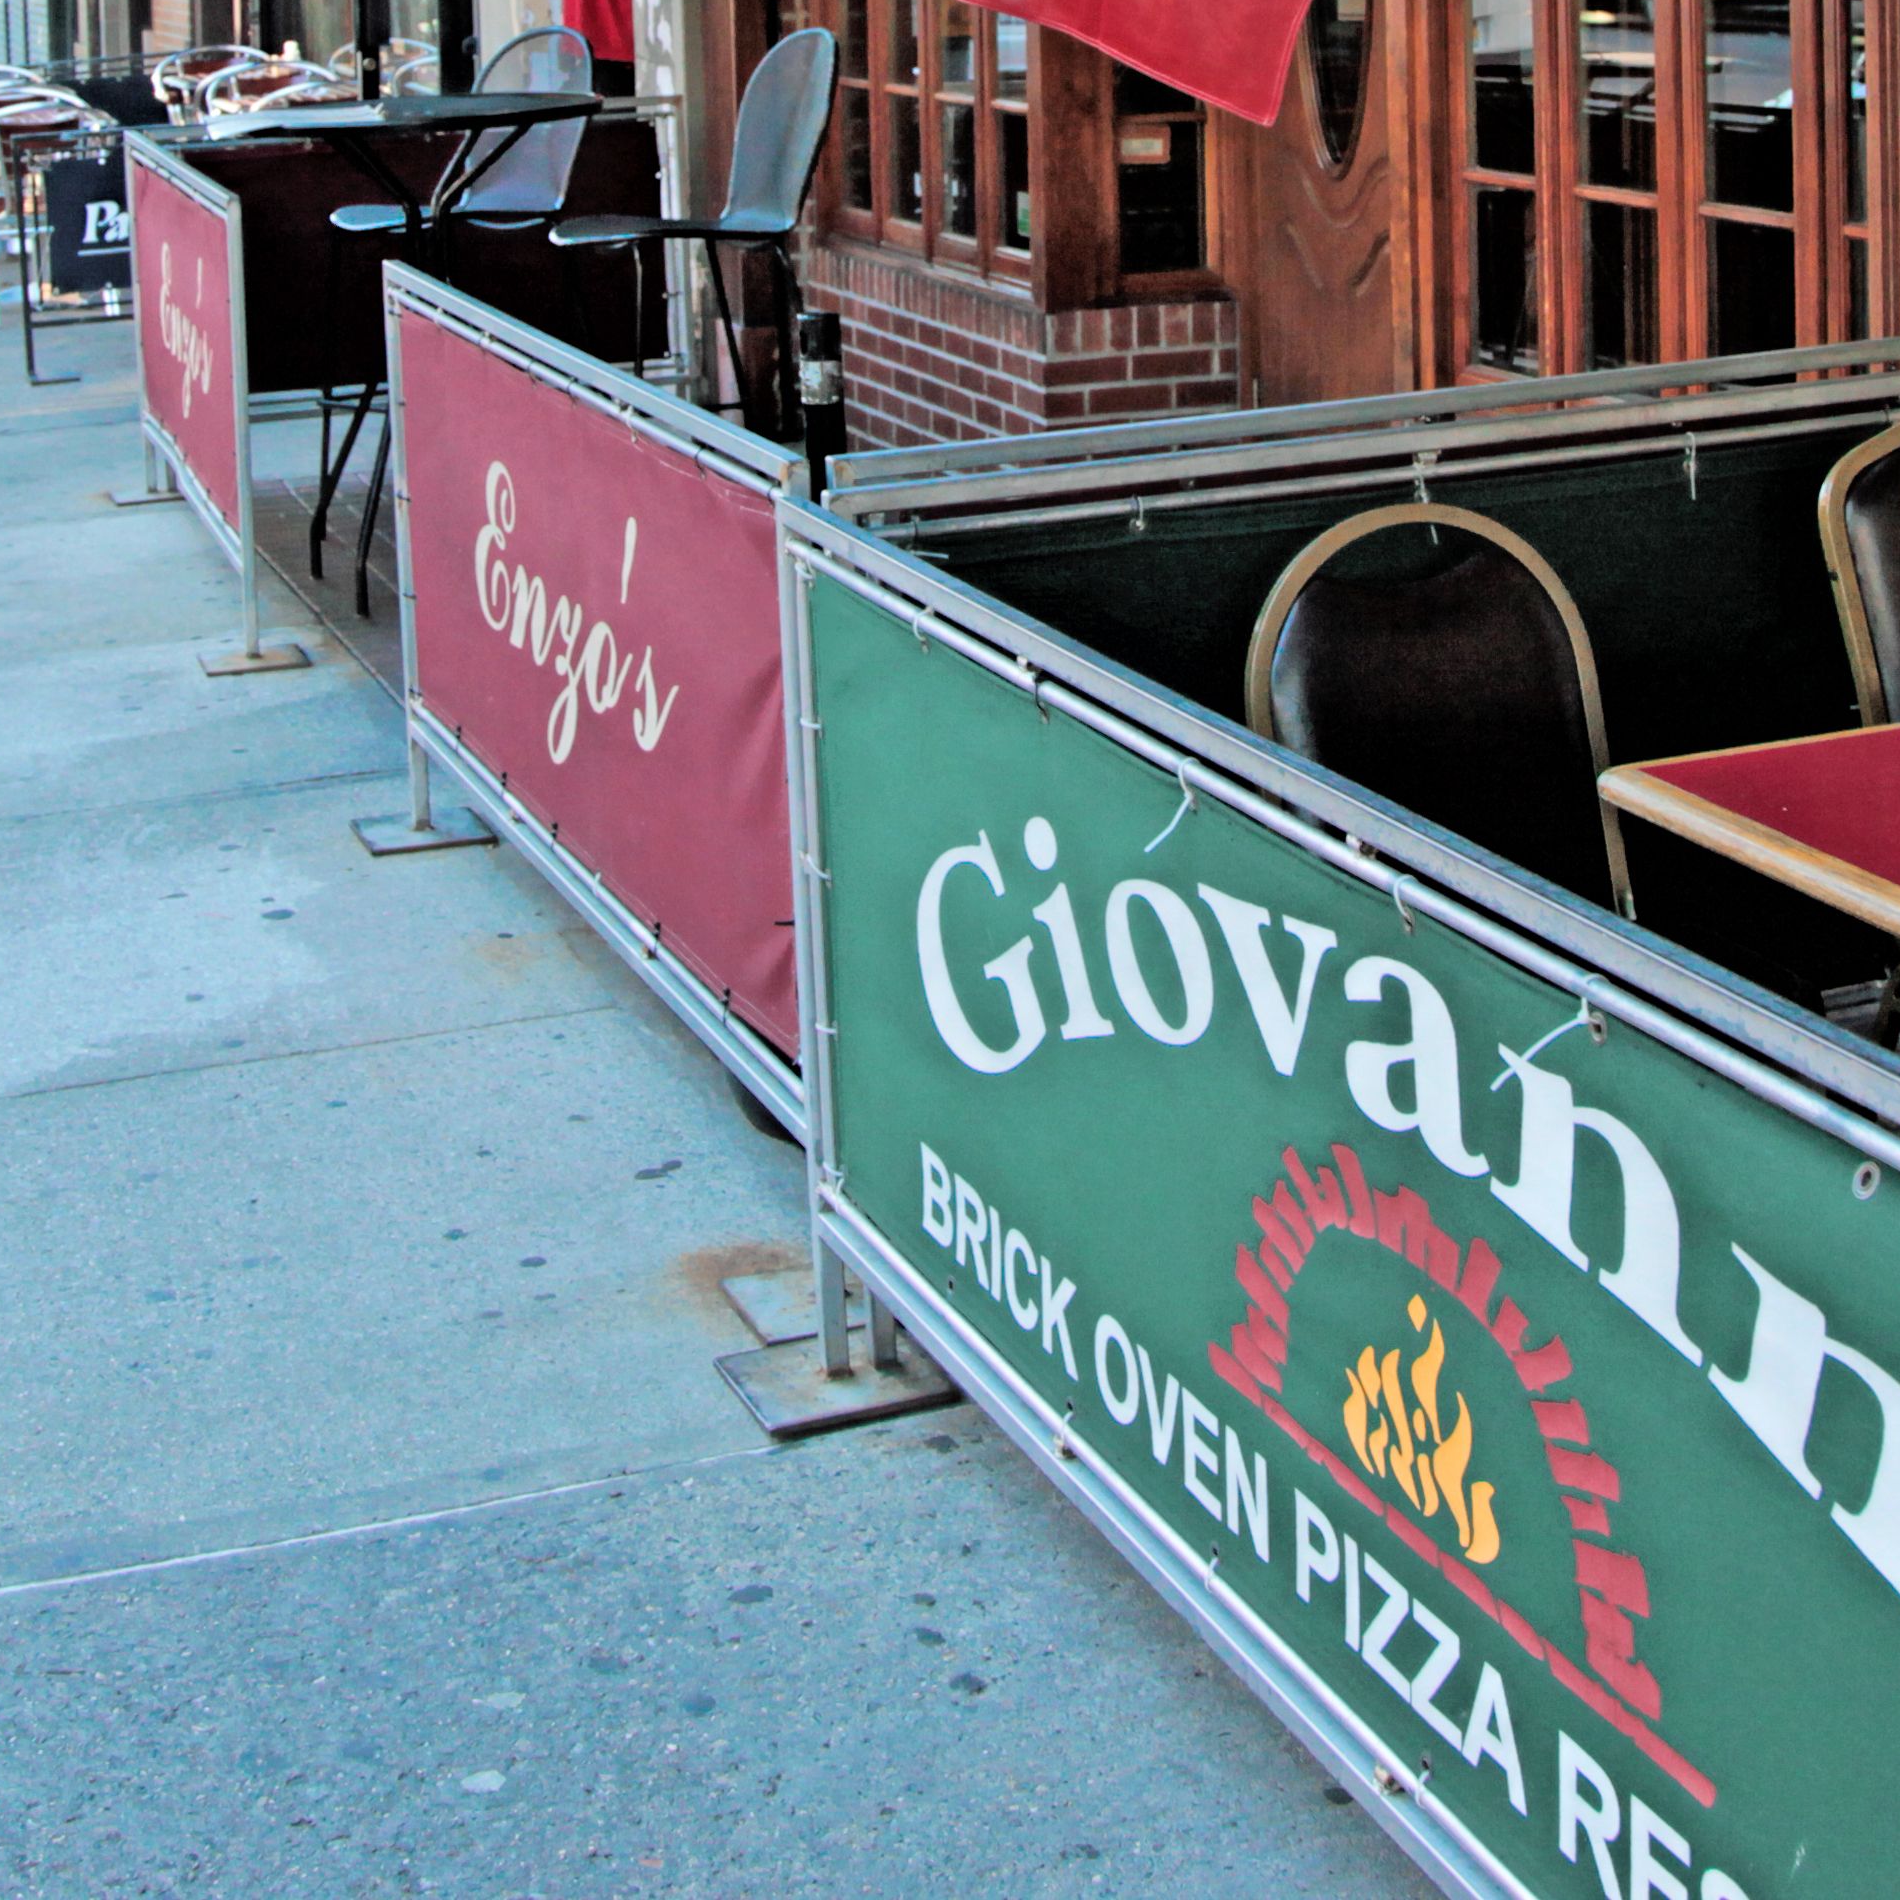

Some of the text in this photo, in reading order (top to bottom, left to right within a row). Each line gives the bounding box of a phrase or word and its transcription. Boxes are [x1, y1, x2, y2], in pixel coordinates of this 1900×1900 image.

[474, 459, 680, 765] Enzo's
[919, 1140, 1755, 1900] BRICK OVEN PIZZA RE
